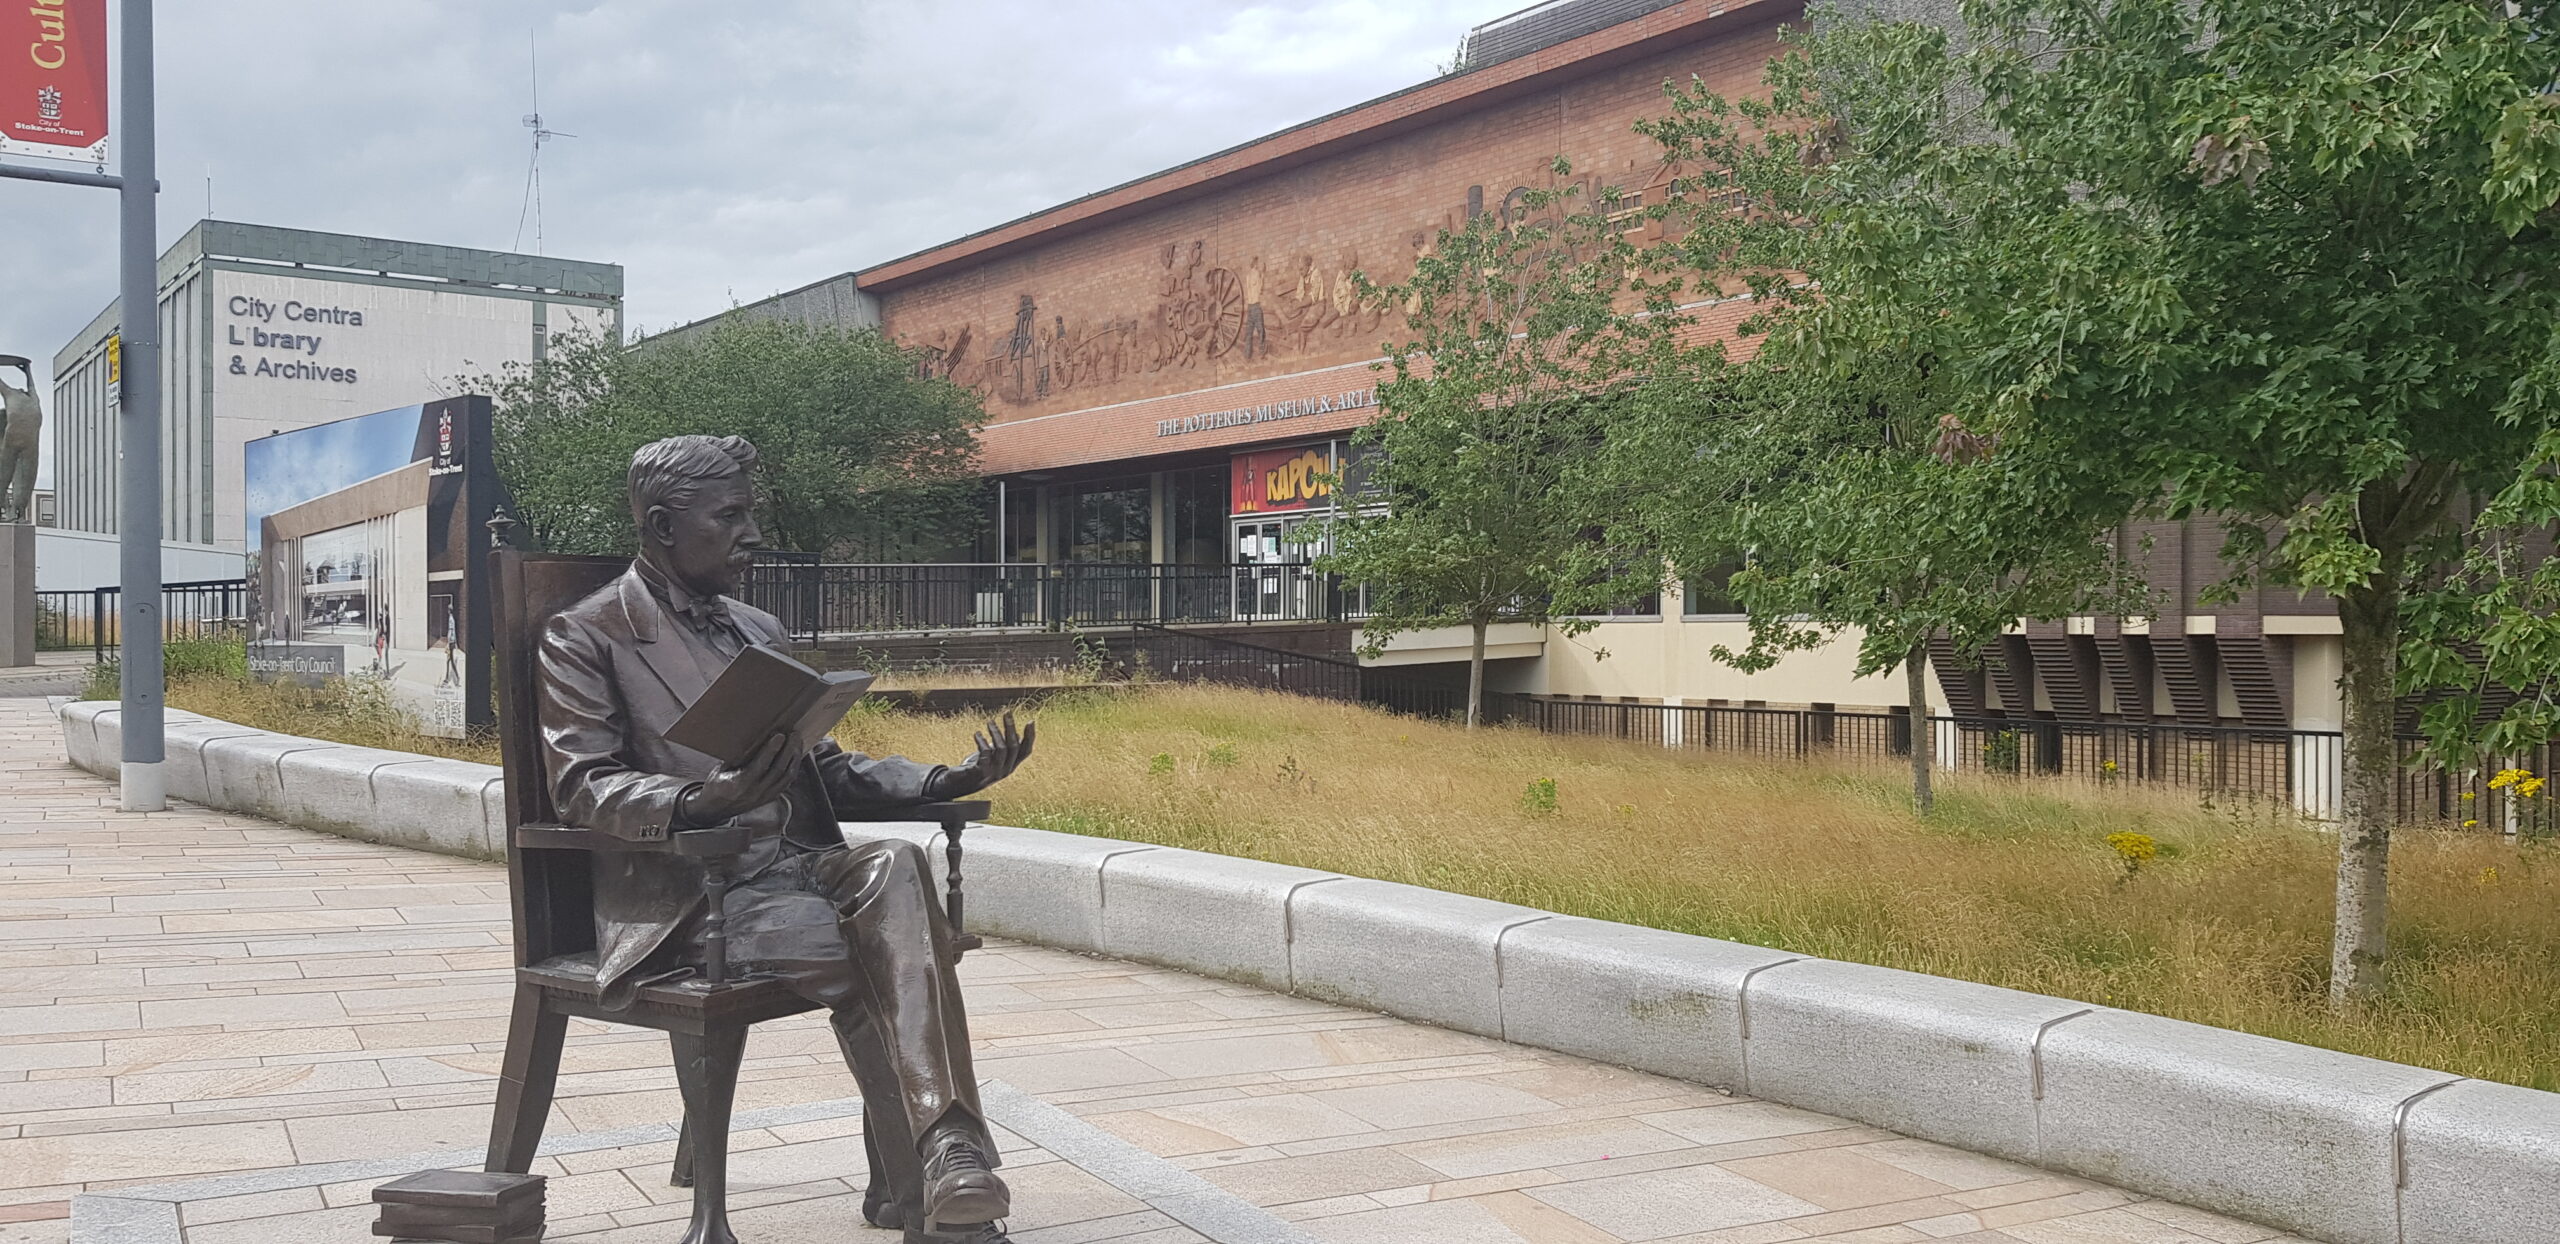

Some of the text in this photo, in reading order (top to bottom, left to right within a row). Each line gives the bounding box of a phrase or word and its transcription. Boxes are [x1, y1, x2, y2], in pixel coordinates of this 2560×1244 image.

[14, 121, 85, 137] Stoke-on-Trent
[39, 119, 52, 127] City
[229, 295, 276, 323] City
[229, 354, 358, 384] & Archives
[1156, 418, 1181, 437] THE
[1183, 406, 1253, 433] POTTERIES
[1256, 396, 1316, 422] MUSEUM
[1320, 394, 1333, 413] &
[1337, 389, 1367, 411] ART
[249, 655, 295, 673] Stoke-on-Trent
[295, 656, 309, 676] City
